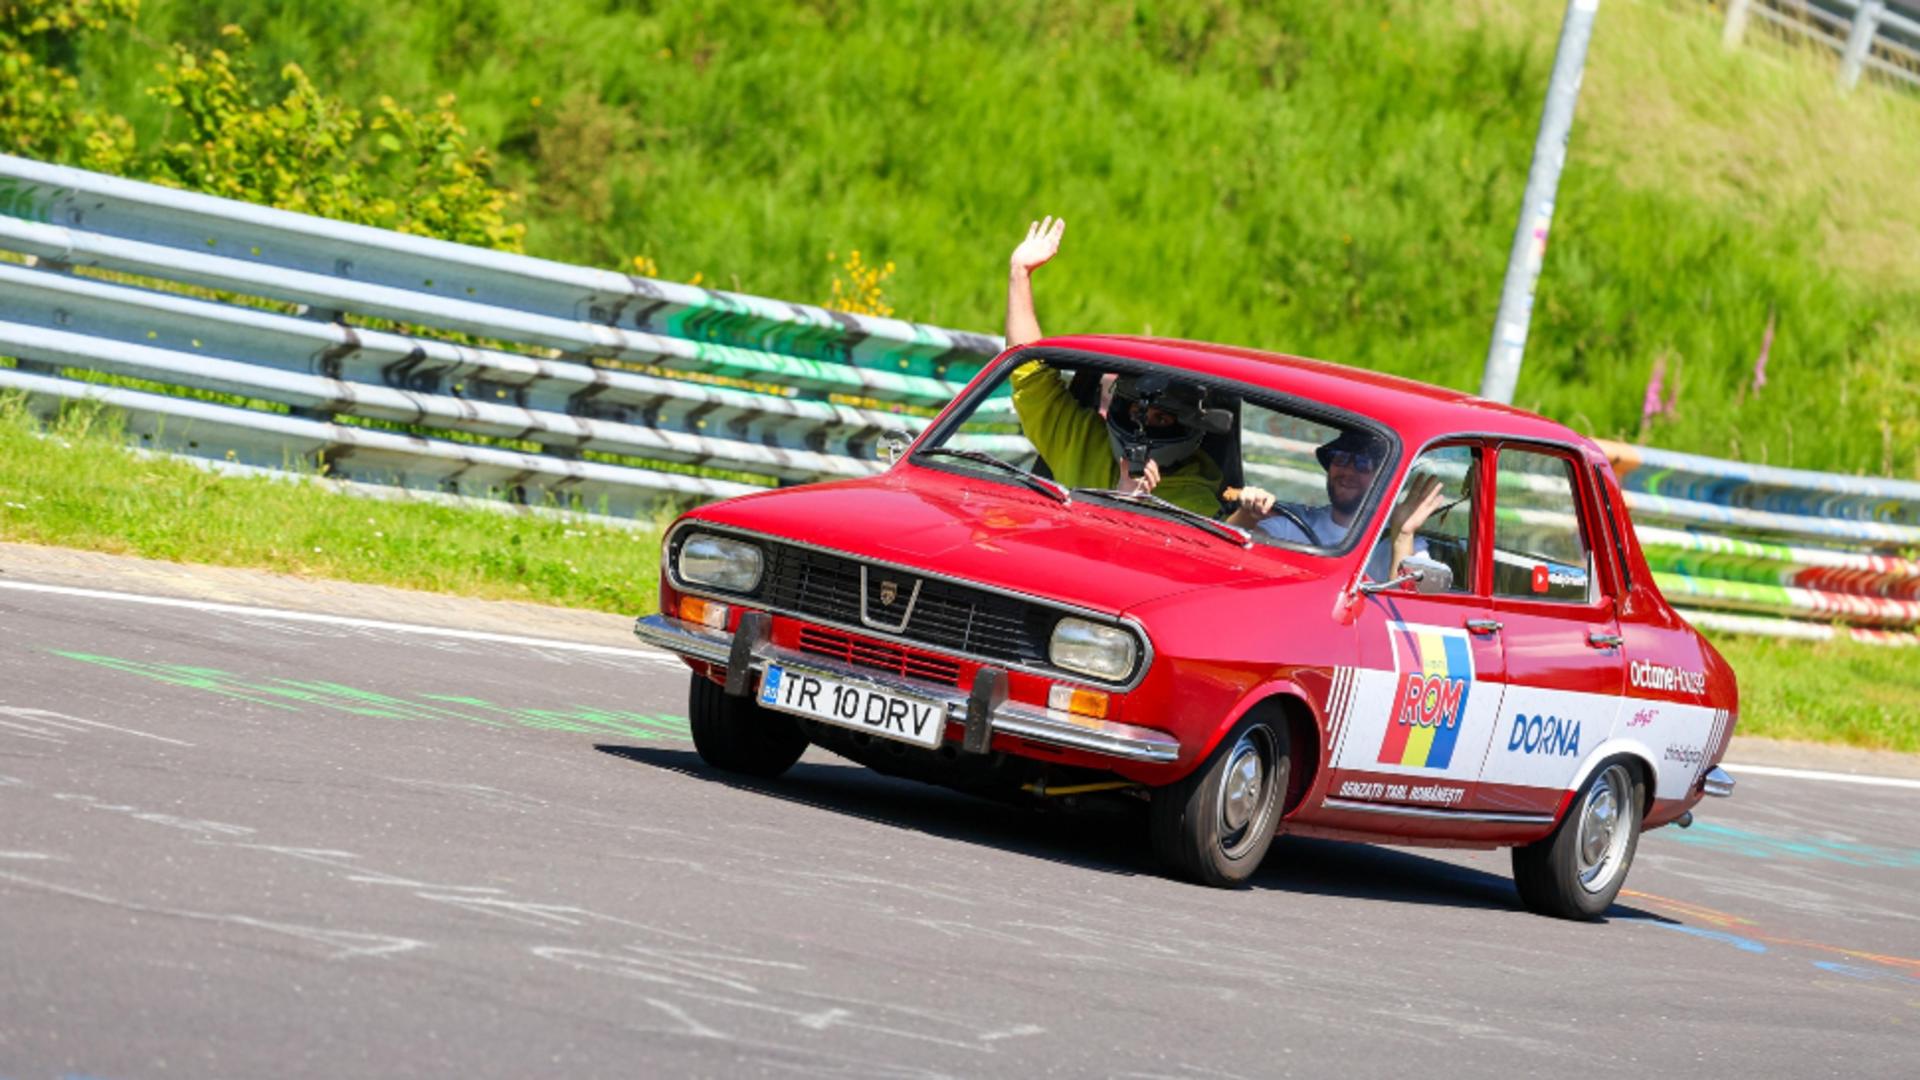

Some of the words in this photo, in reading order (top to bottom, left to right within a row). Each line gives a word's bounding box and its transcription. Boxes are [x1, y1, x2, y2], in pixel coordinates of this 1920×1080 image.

[785, 672, 822, 711] TR
[833, 685, 860, 719] 10
[863, 693, 932, 737] DRV
[1400, 673, 1464, 729] ROM
[1507, 713, 1581, 758] DORNA
